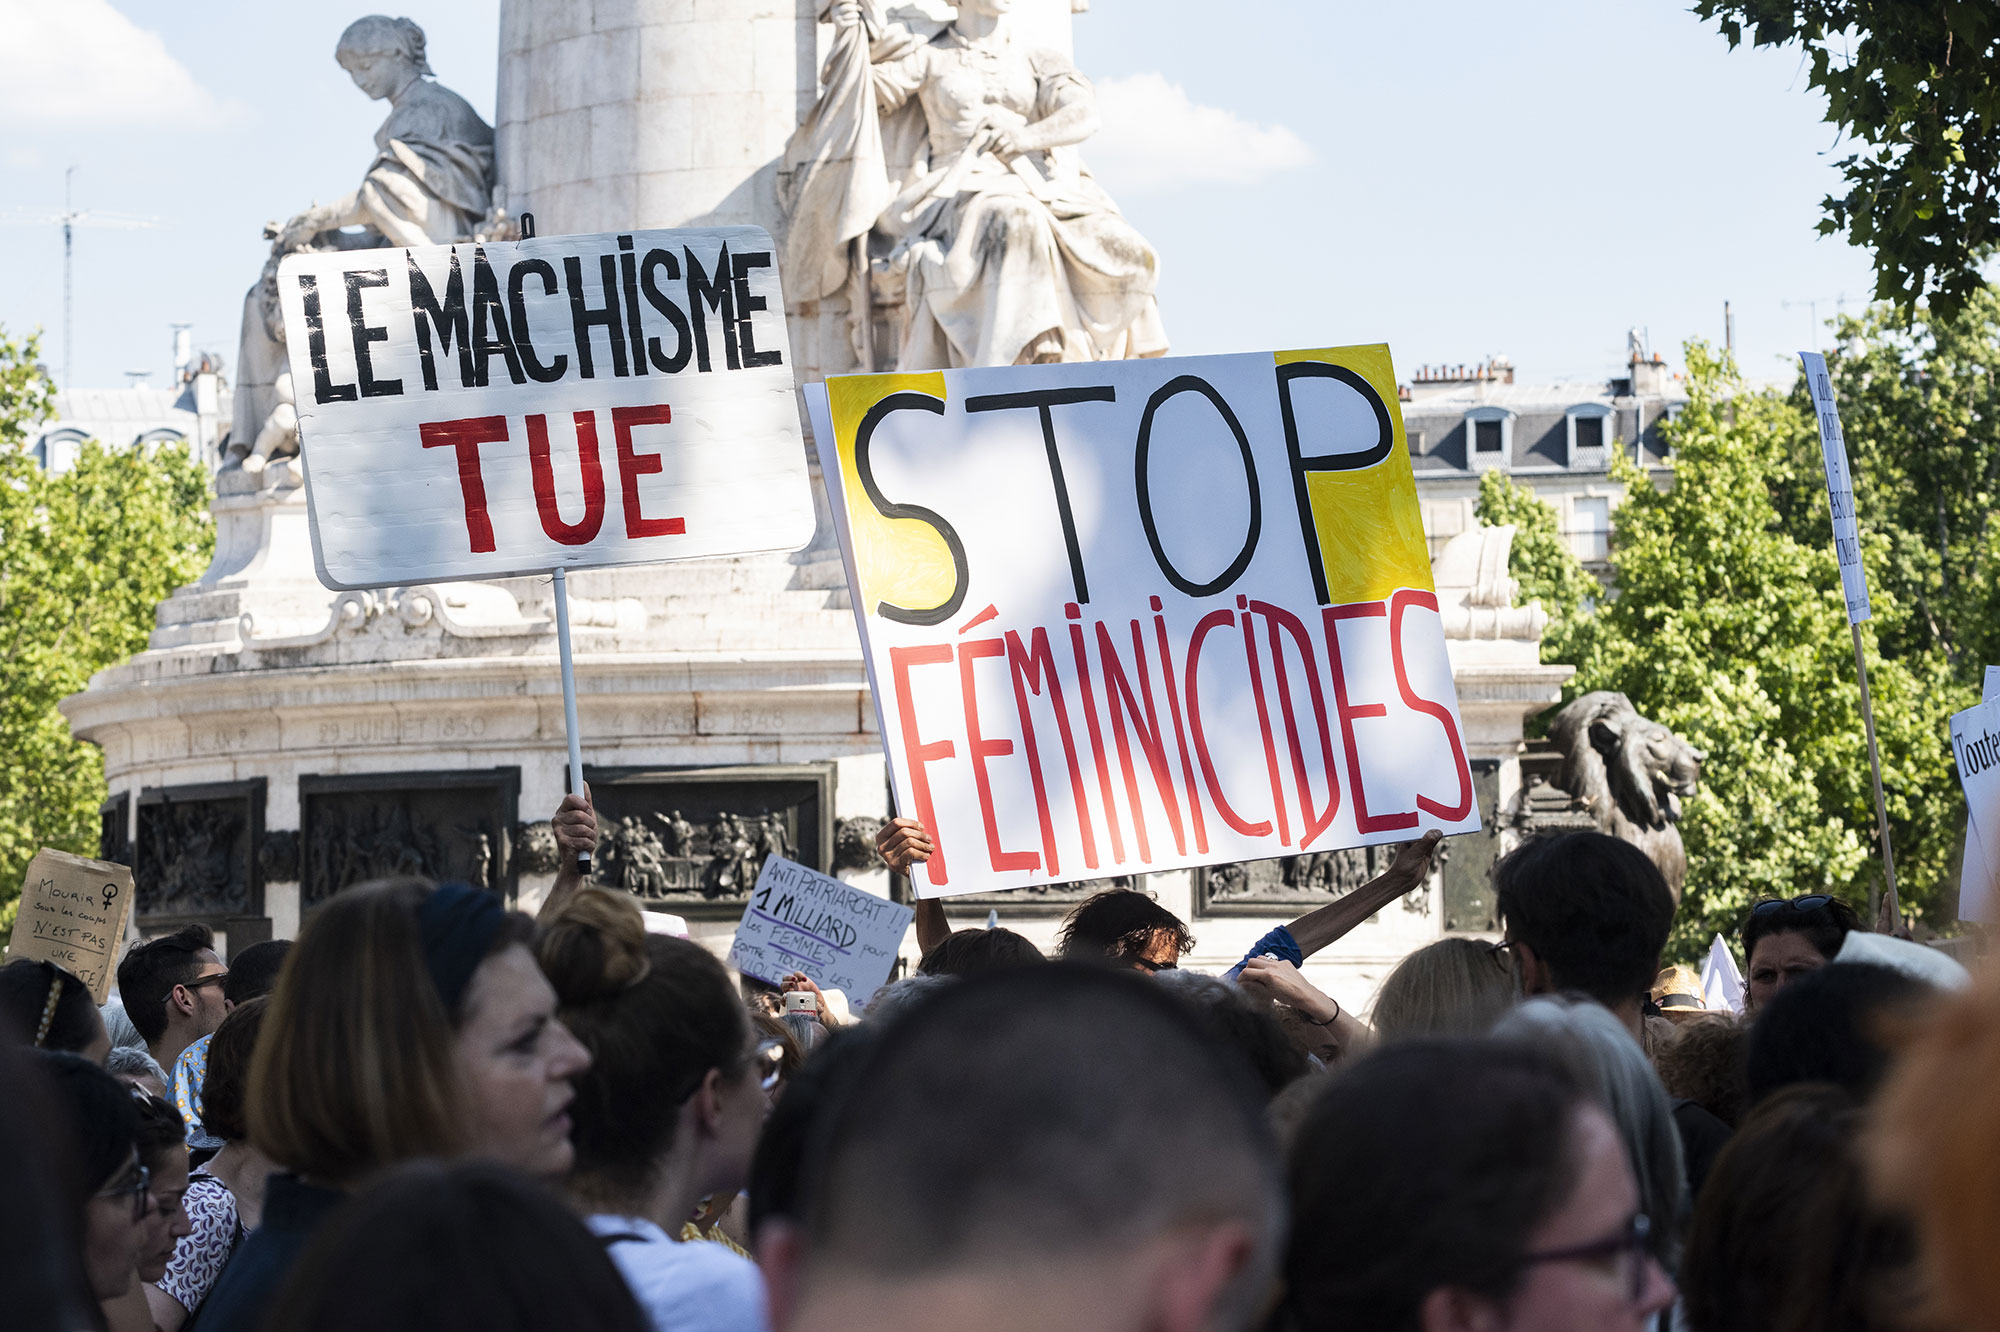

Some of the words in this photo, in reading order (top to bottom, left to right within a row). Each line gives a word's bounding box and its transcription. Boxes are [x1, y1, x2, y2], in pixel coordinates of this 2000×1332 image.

[298, 268, 404, 404] LE
[405, 235, 783, 391] MACHISME
[419, 404, 686, 553] TUE
[854, 360, 1393, 626] STOP
[889, 590, 1473, 886] FÉMINICIDES
[1954, 727, 2000, 778] Toute
[78, 912, 107, 925] coups
[756, 887, 772, 911] 1
[773, 893, 857, 948] MILLIARD
[768, 862, 796, 887] ANTI
[796, 870, 888, 921] PATRIARCAT
[32, 920, 81, 937] N'EST
[81, 932, 106, 949] PAS
[51, 949, 77, 963] UNE
[769, 925, 839, 965] FEMMES
[775, 950, 823, 979] TOUTES
[829, 972, 854, 990] LES
